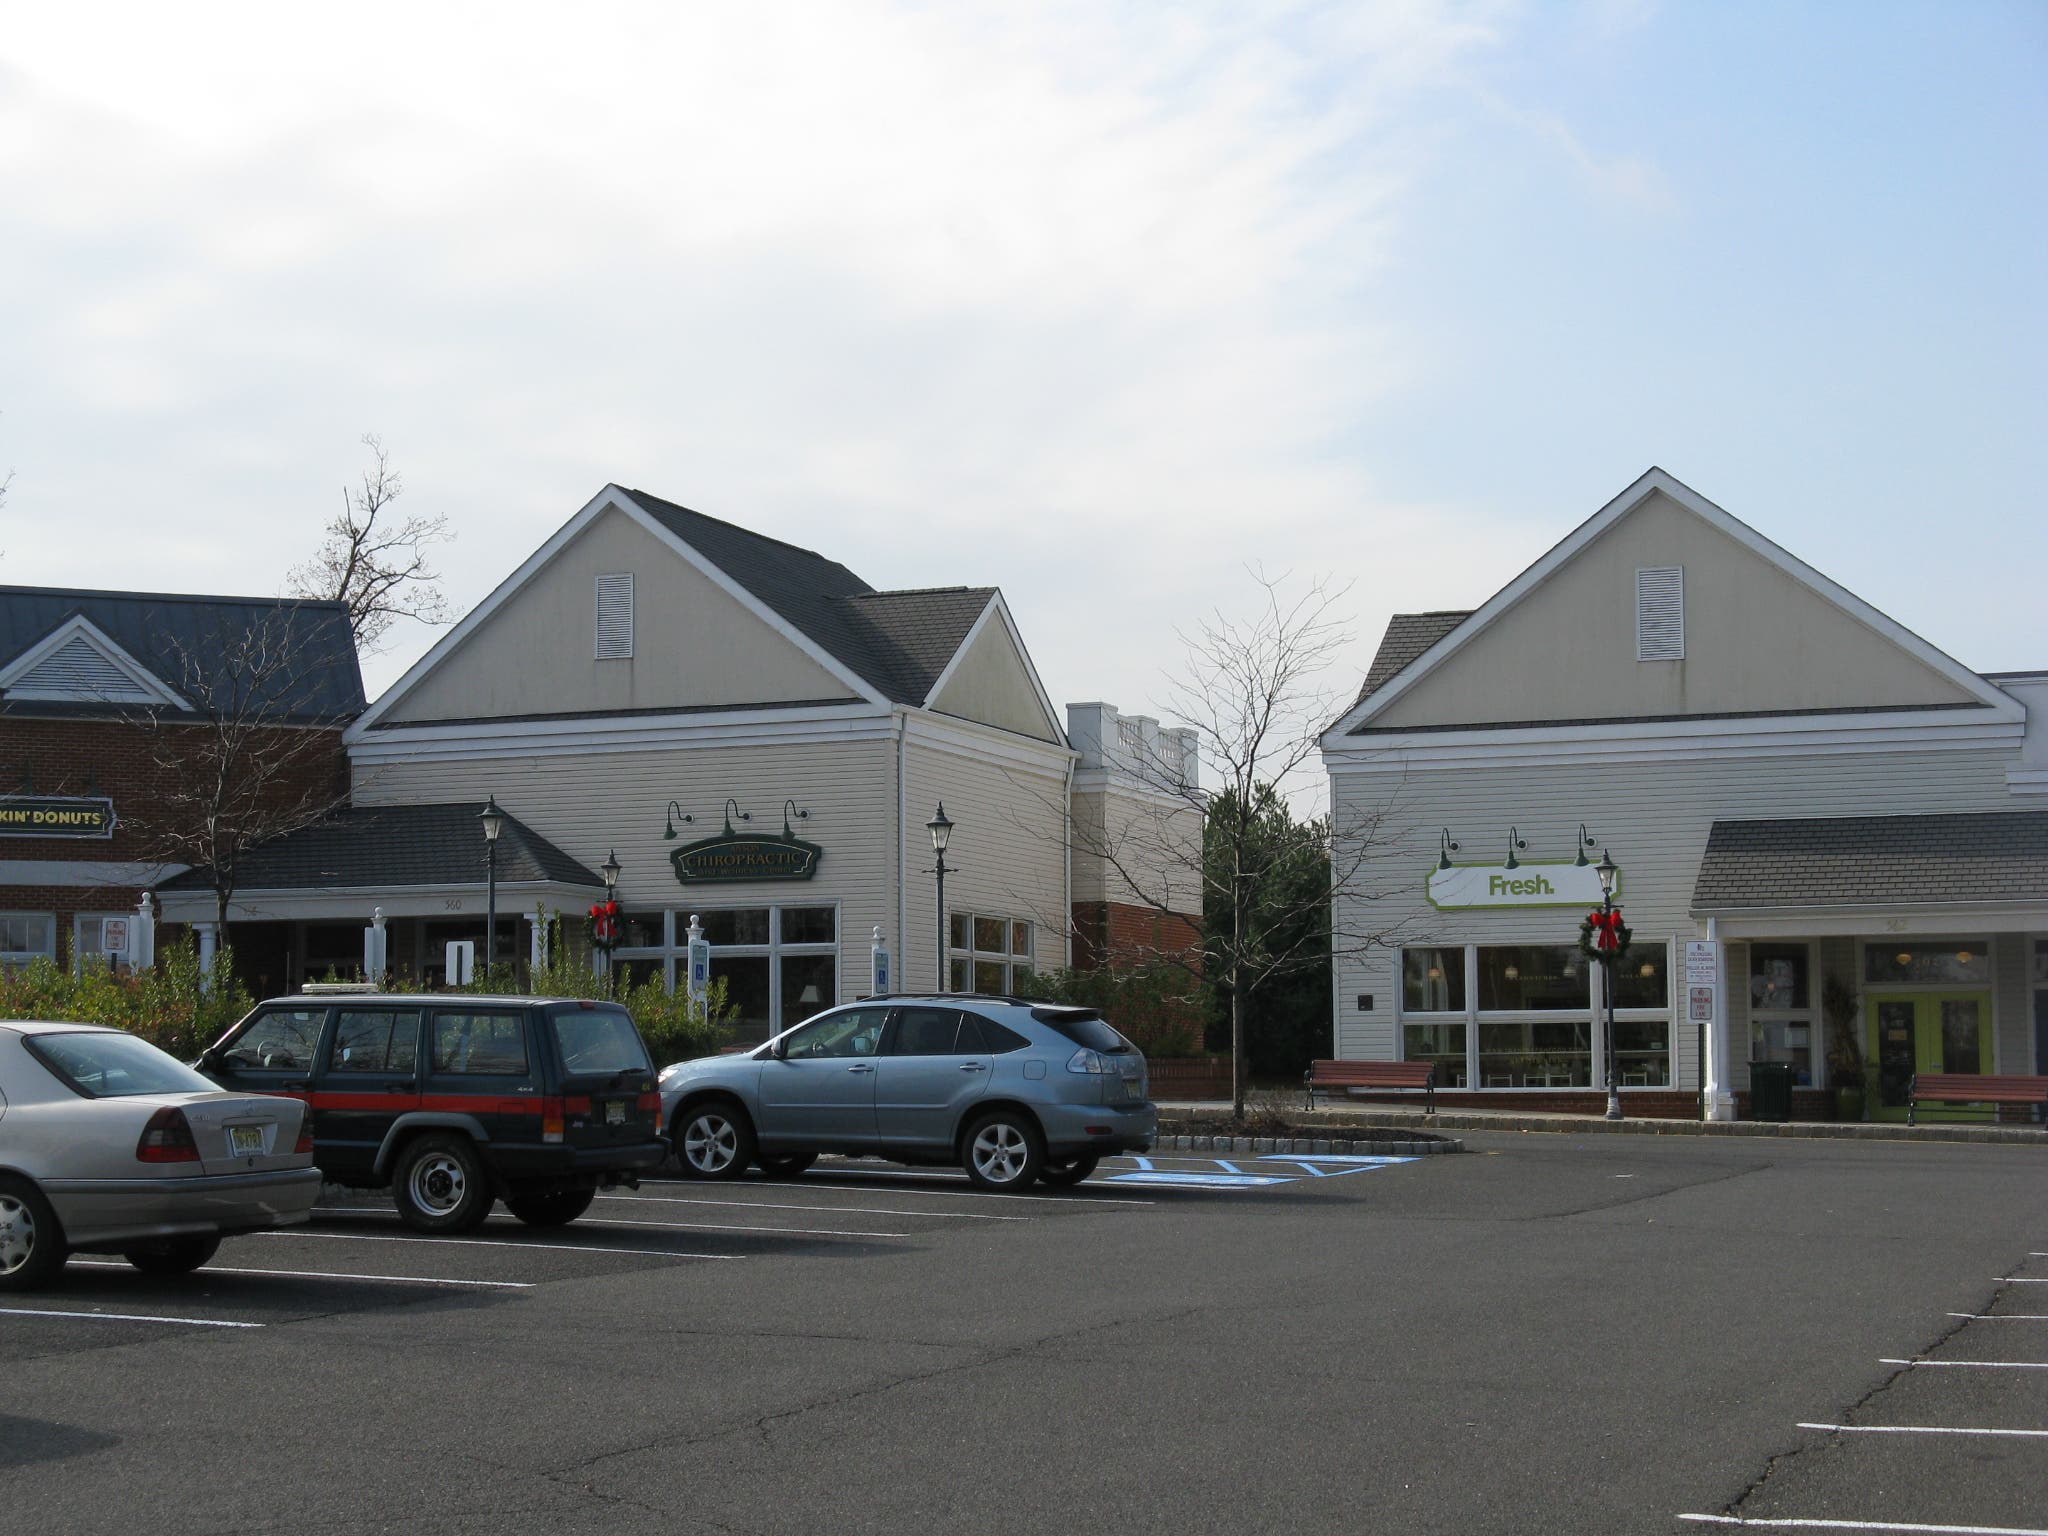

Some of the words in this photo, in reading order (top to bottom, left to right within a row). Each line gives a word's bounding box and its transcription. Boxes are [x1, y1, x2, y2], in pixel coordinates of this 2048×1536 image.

[33, 811, 102, 825] DONUTS
[686, 851, 800, 868] CHIROPRACTIC
[1489, 874, 1554, 896] Fresh.
